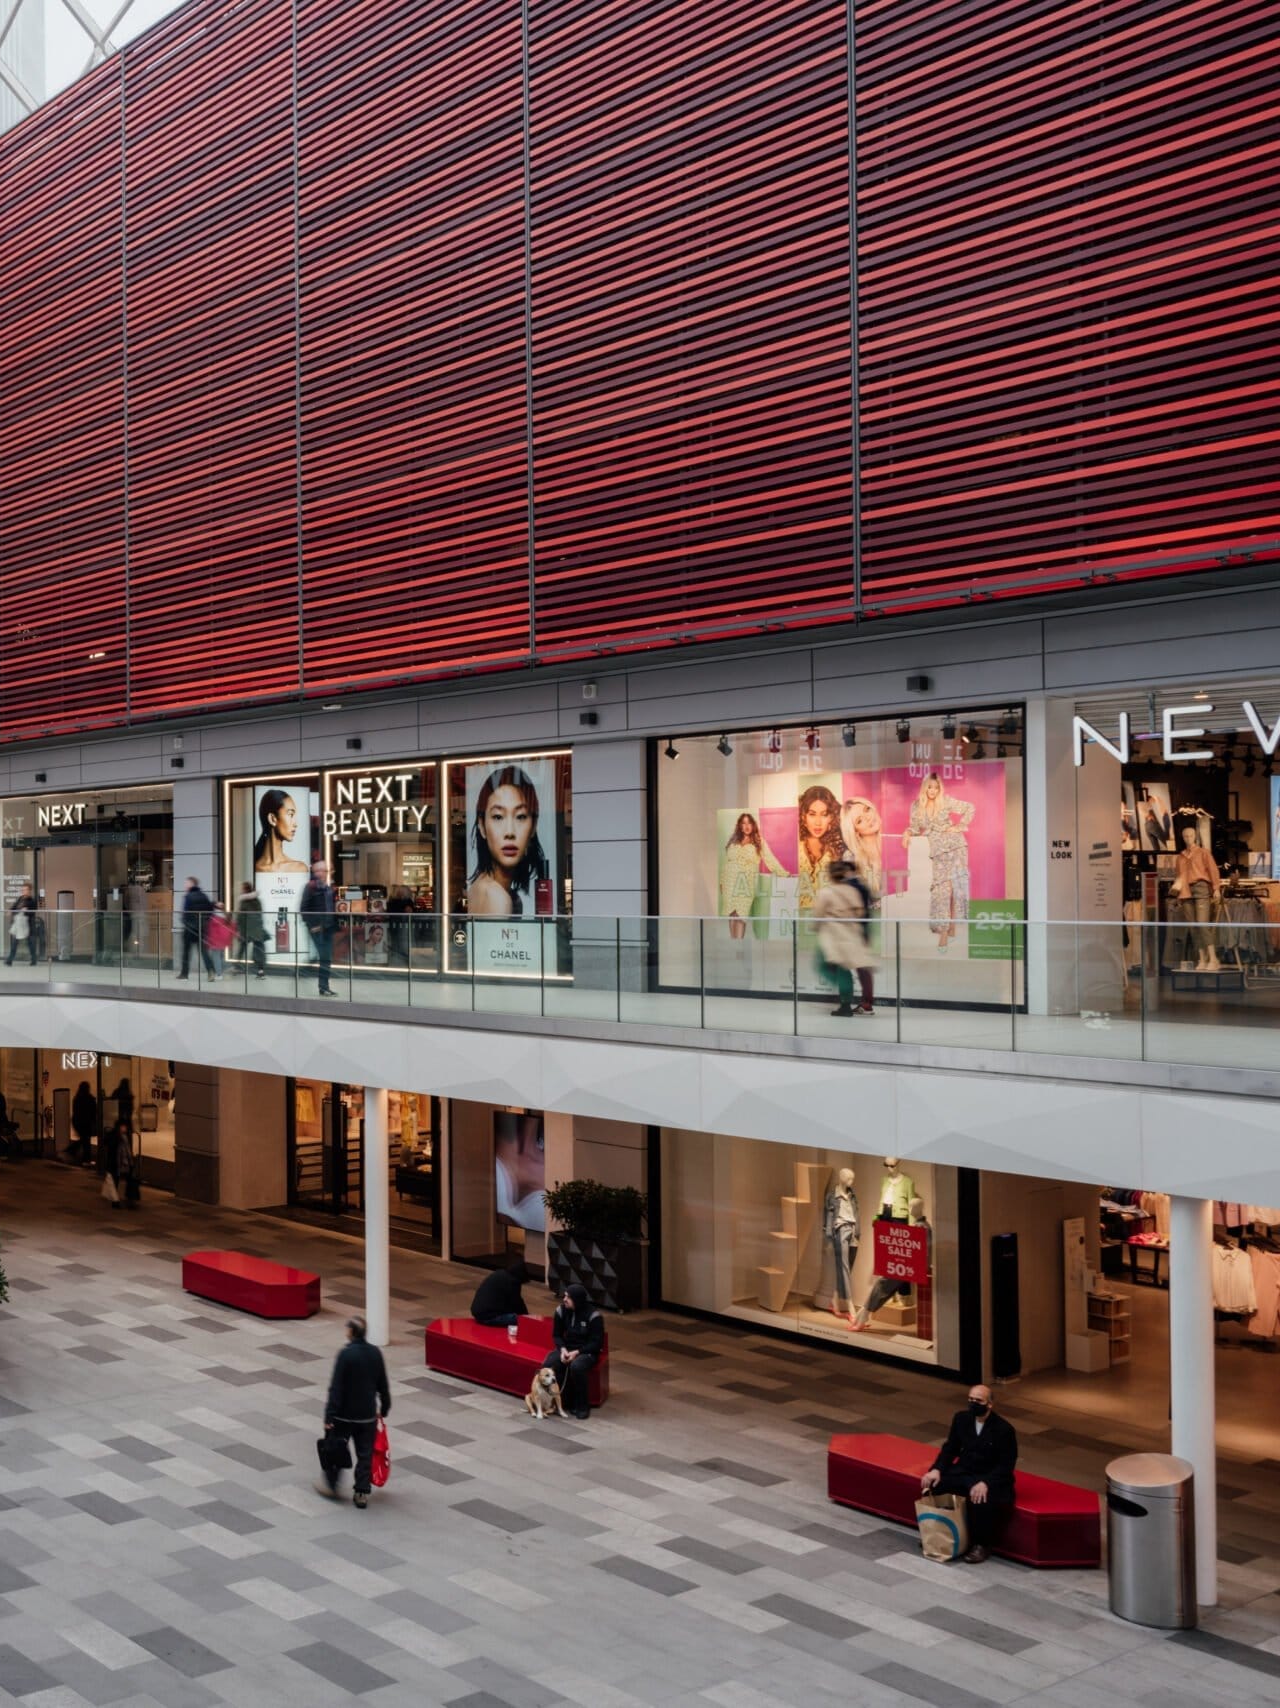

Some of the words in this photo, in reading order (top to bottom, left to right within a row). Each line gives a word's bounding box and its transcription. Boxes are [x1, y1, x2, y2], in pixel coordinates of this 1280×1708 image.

[336, 775, 413, 805] NEXT
[38, 804, 86, 828] NEXT
[323, 805, 428, 836] BEAUTY
[1052, 840, 1071, 848] NEW
[1051, 851, 1072, 859] LOOK
[490, 949, 532, 961] CHANEL
[889, 1228, 910, 1239] MID
[879, 1235, 921, 1250] SEASON
[888, 1246, 912, 1258] SALE
[887, 1262, 914, 1277] 50%
